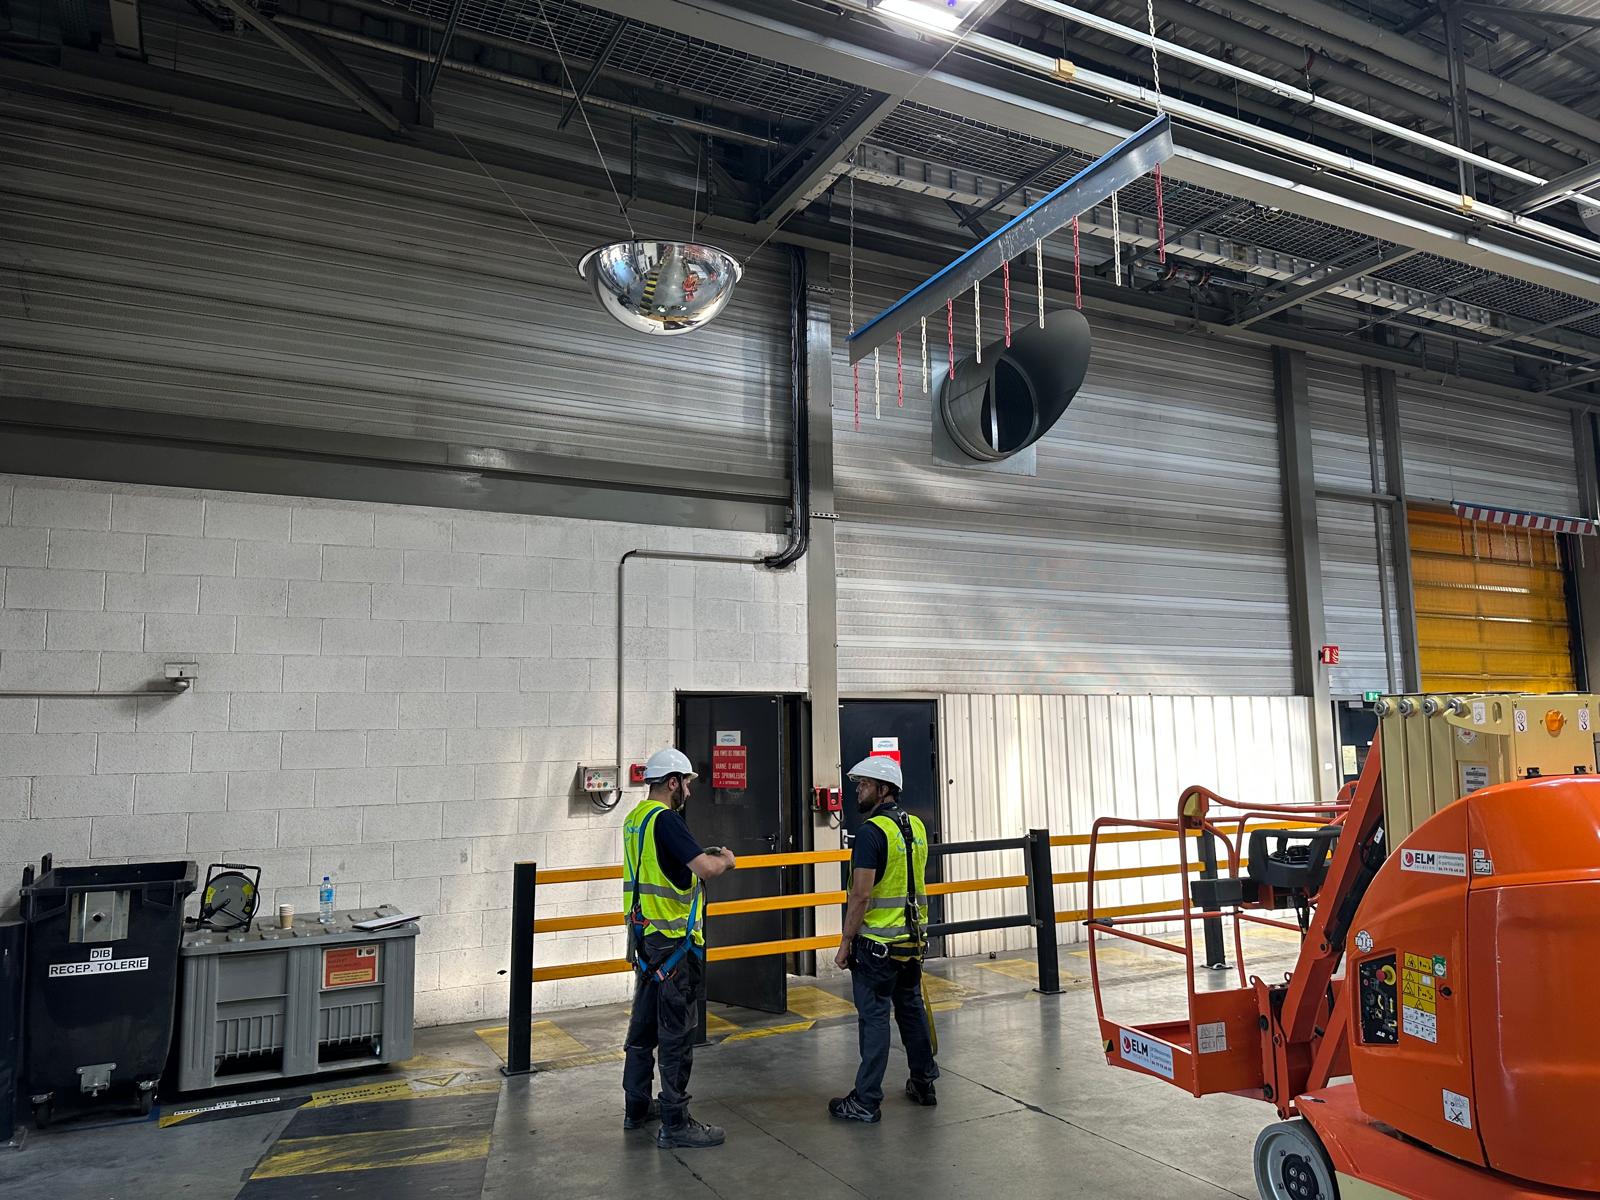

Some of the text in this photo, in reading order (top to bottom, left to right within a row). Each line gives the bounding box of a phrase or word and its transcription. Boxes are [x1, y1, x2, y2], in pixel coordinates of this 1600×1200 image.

[1414, 852, 1435, 865] ELM
[91, 949, 111, 959] DIB
[50, 959, 147, 976] RECEP. TOLERIE
[1131, 1038, 1148, 1057] ELM
